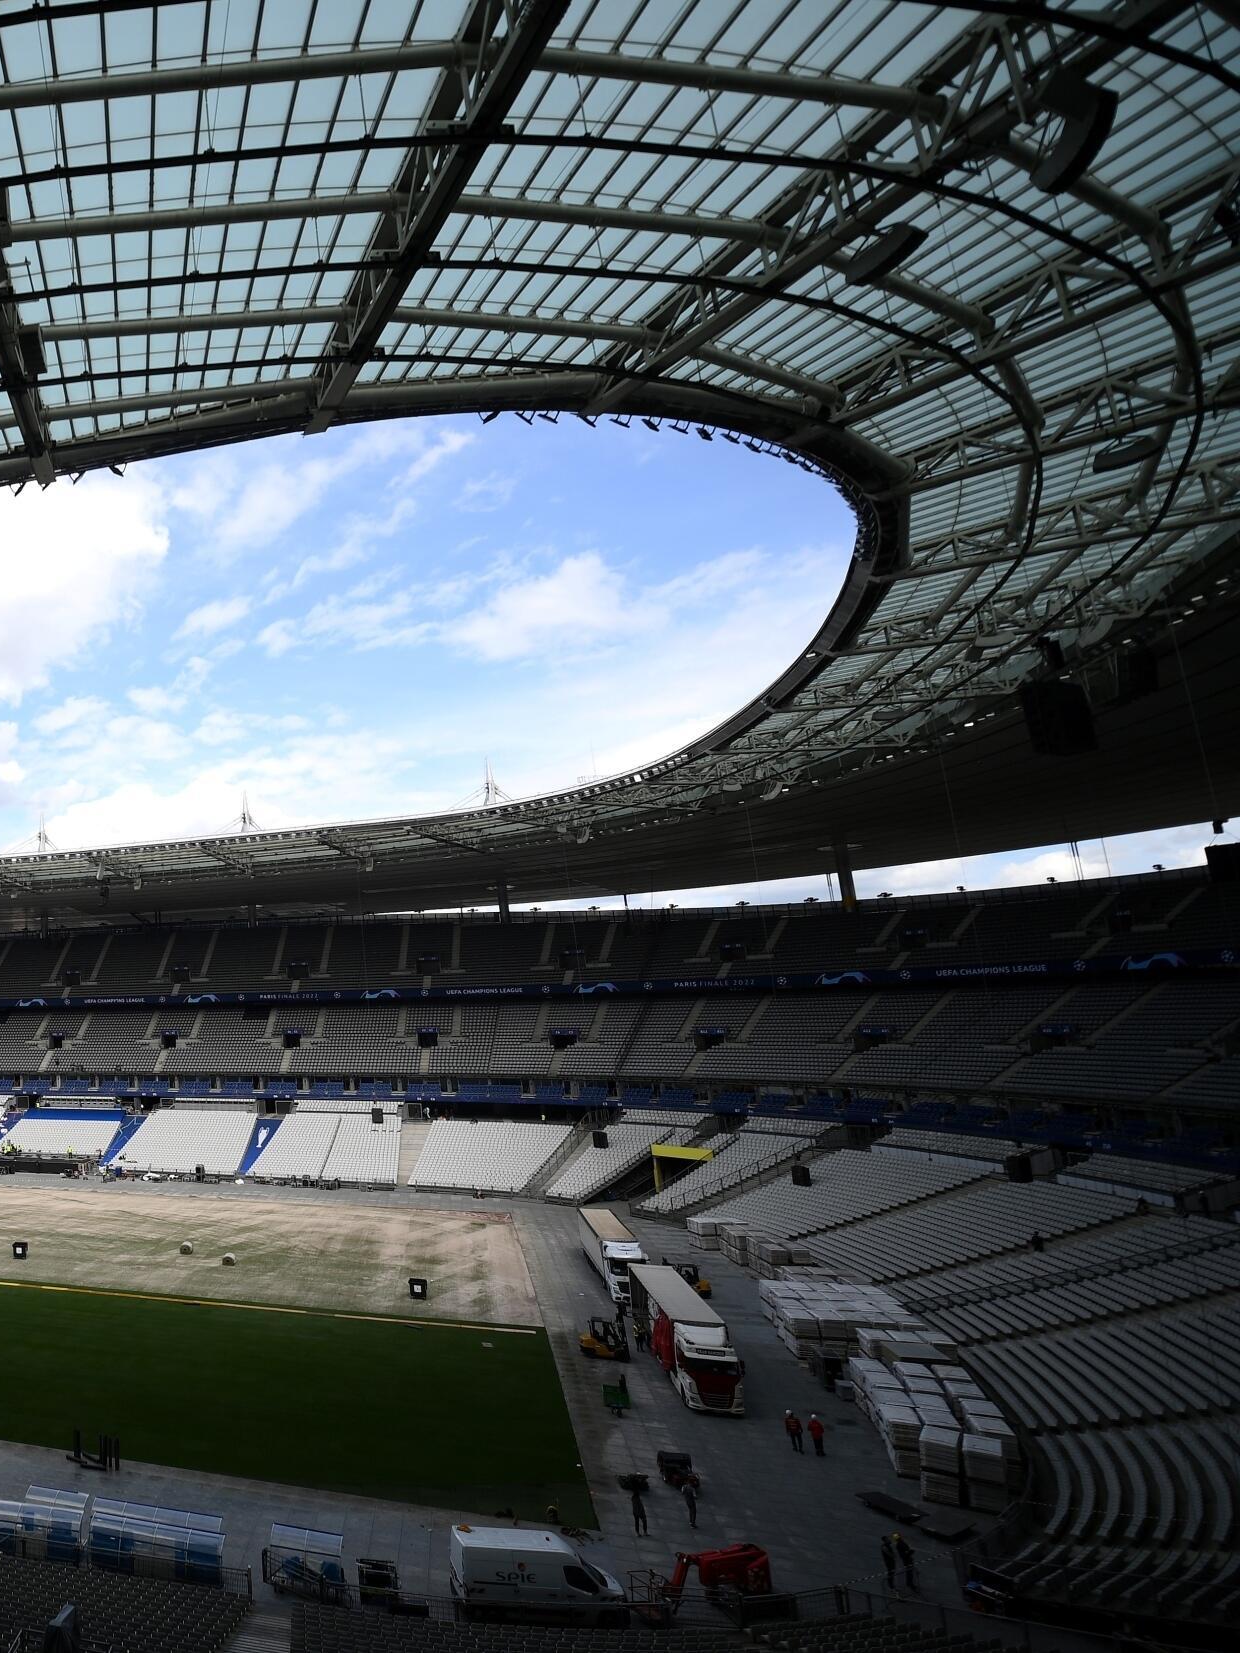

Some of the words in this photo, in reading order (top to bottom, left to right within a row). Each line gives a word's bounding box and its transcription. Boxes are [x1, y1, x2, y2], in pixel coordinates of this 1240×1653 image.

[960, 966, 1010, 976] CHAMPIONS
[1013, 964, 1048, 973] LEAGUE
[496, 1571, 536, 1583] SPIE
